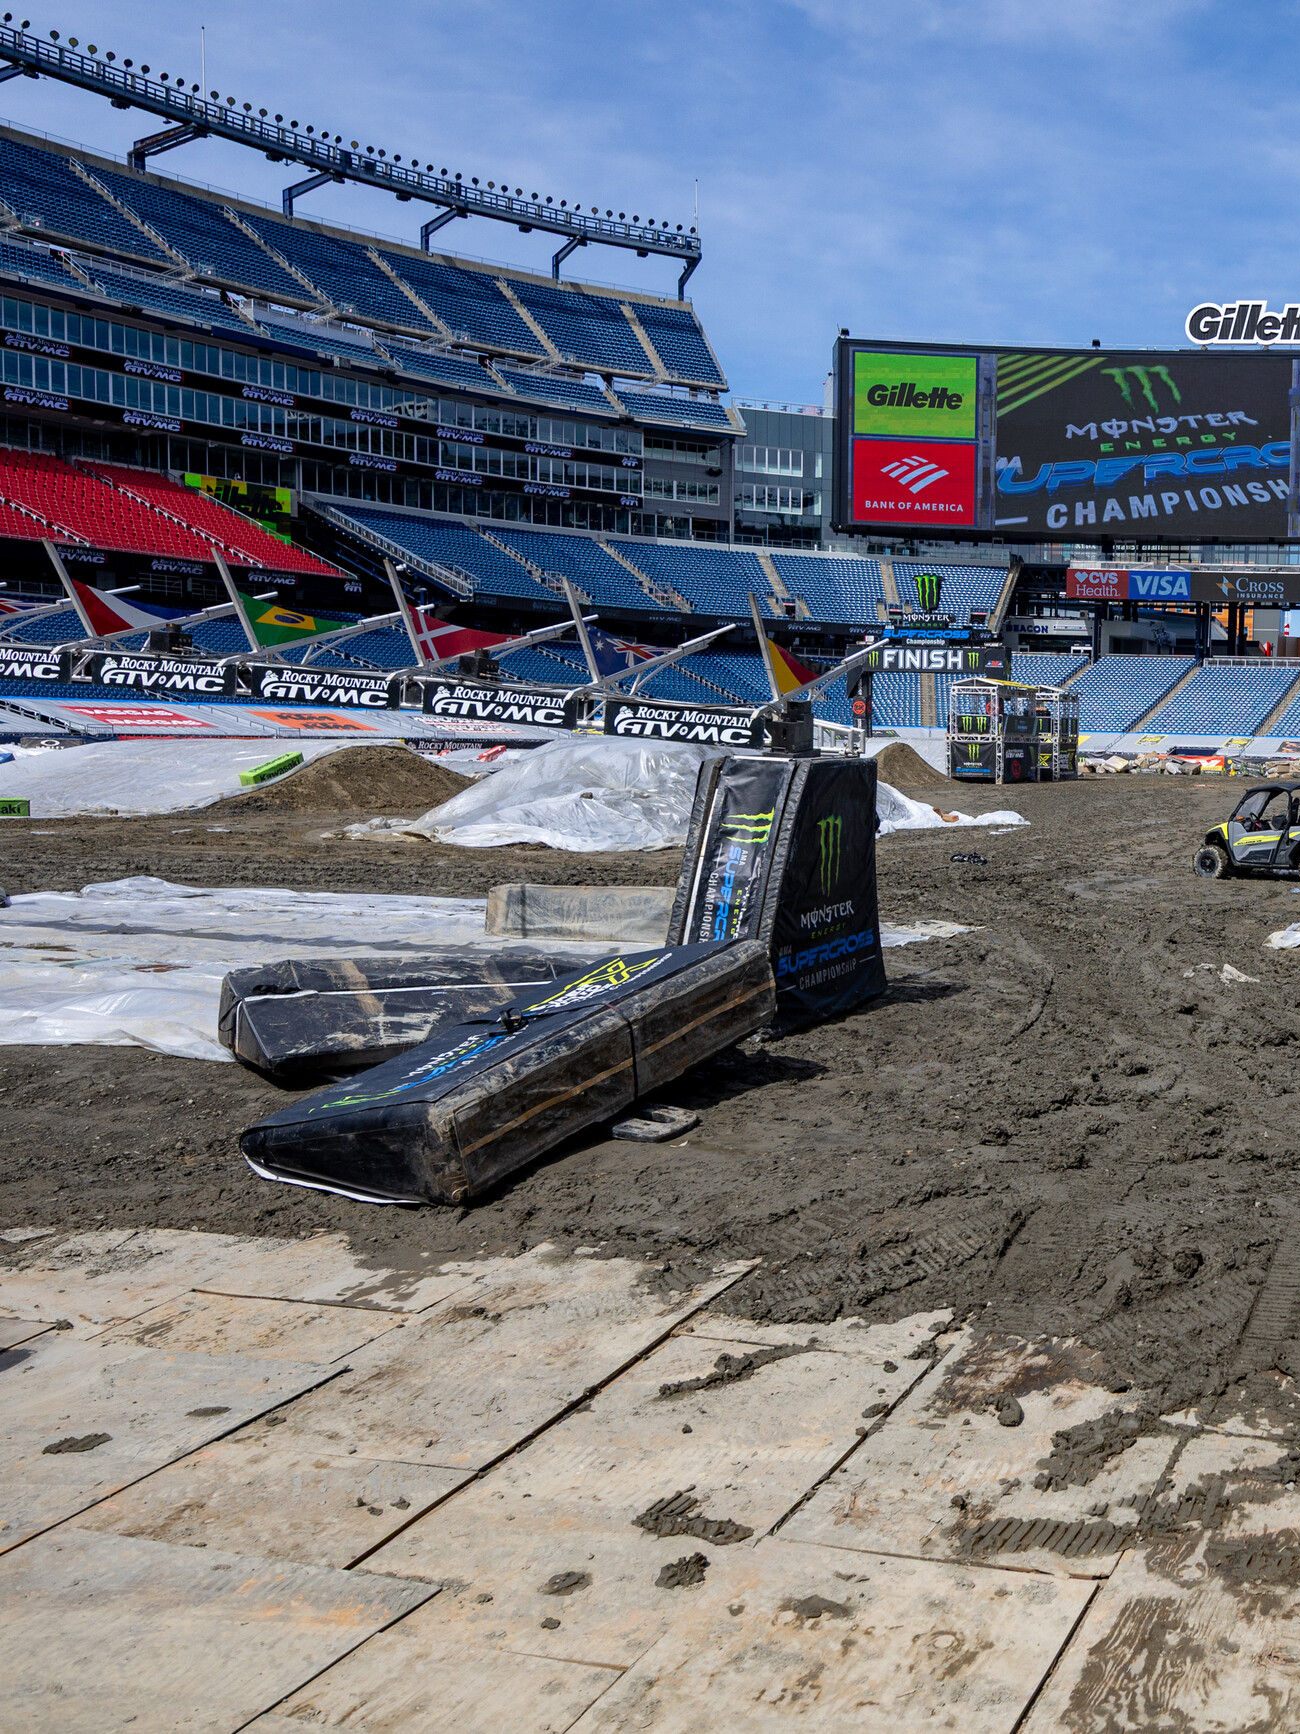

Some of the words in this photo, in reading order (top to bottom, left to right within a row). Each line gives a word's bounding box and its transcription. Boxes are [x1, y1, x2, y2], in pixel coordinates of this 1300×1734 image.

[15, 334, 36, 343] ROCKY
[37, 338, 69, 349] MOUNTAIN
[15, 388, 34, 397] ROCKY
[36, 392, 68, 403] MOUNTAIN
[867, 383, 963, 410] Gillette
[1065, 410, 1259, 440] MONSTER
[1100, 432, 1237, 453] ENERGY
[865, 500, 895, 510] BANK
[898, 501, 911, 510] OF
[913, 502, 964, 512] AMERICA
[1089, 571, 1118, 584] CVS
[1131, 575, 1188, 596] VISA
[1076, 584, 1119, 597] Health
[882, 629, 970, 639] SUPERCROSS
[1006, 624, 1049, 634] BEACON
[906, 638, 945, 646] Championship
[0, 649, 61, 664] MOUNTAIN
[883, 648, 964, 670] FINISH
[4, 663, 60, 679] MC
[120, 657, 157, 670] ROCKY
[162, 661, 226, 676] MOUNTAIN
[166, 675, 225, 692] MC
[280, 670, 320, 684] ROCKY
[322, 674, 389, 690] MOUNTAIN
[329, 689, 389, 706] MC
[452, 686, 494, 700] ROCKY
[496, 690, 566, 709] MOUNTAIN
[502, 706, 565, 724] MC
[635, 707, 678, 720] ROCKY
[681, 710, 752, 729] MOUNTAIN
[688, 726, 752, 745] MC
[418, 741, 443, 749] ROCKY
[800, 900, 855, 929] MONSTER
[811, 922, 847, 940] ENERGY
[776, 927, 874, 978] SUPERCROSS
[800, 958, 857, 990] CHAMPIONSHIP
